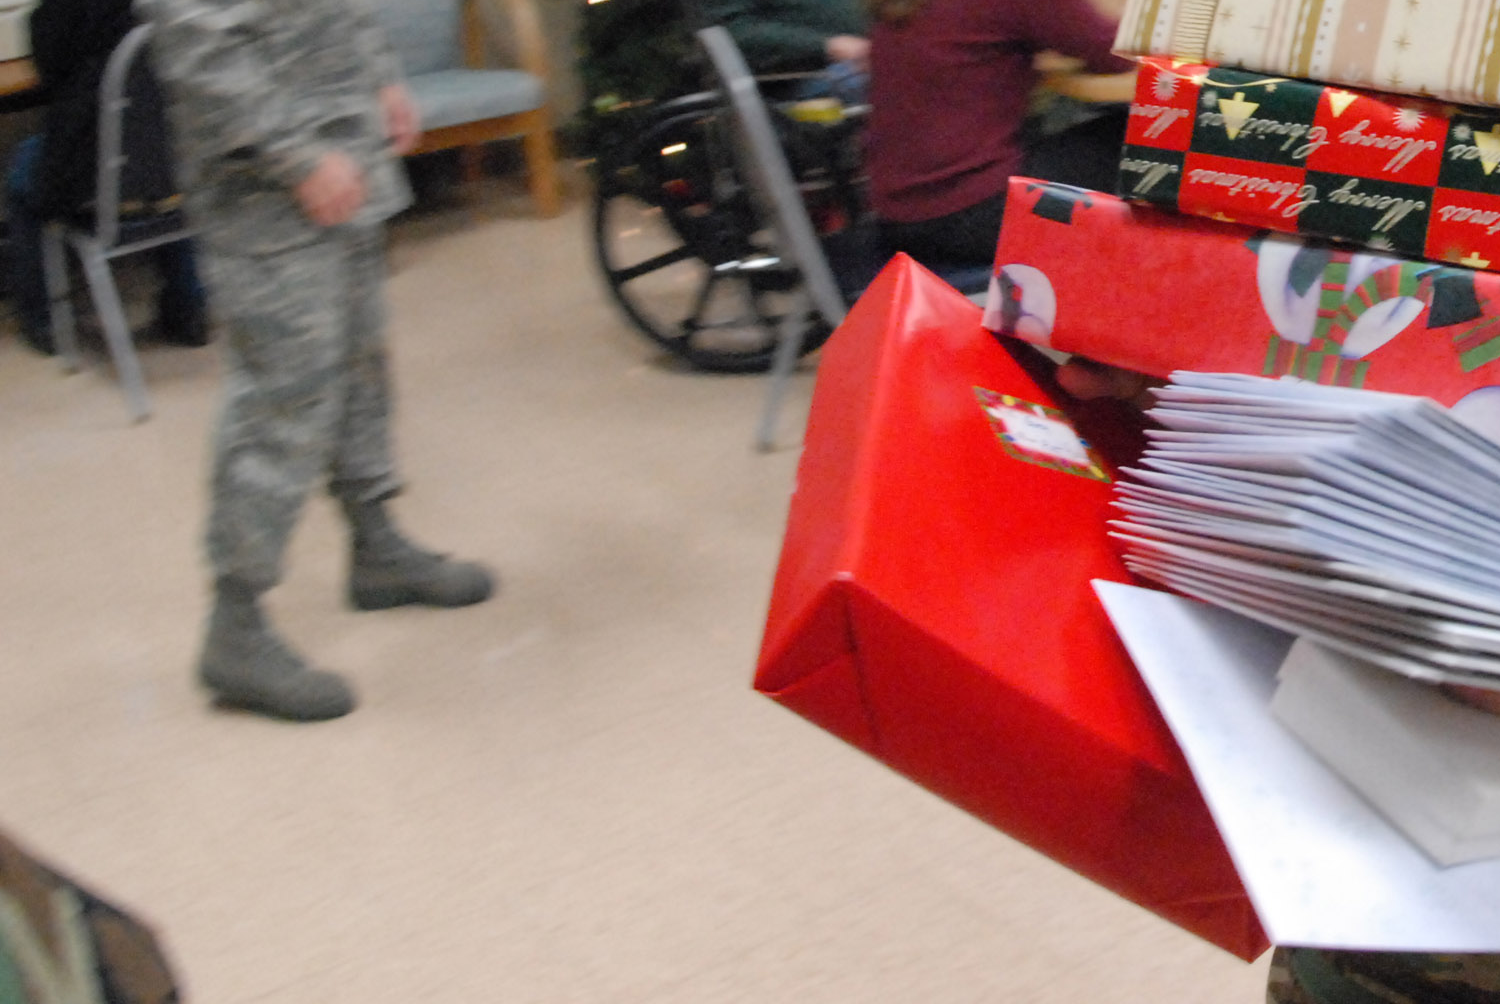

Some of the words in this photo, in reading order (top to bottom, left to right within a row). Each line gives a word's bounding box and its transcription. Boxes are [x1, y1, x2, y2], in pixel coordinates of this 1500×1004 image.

[1200, 110, 1330, 159] Christmas
[1339, 119, 1437, 174] Merry
[1188, 168, 1320, 219] Christmas
[1328, 178, 1426, 233] Merry
